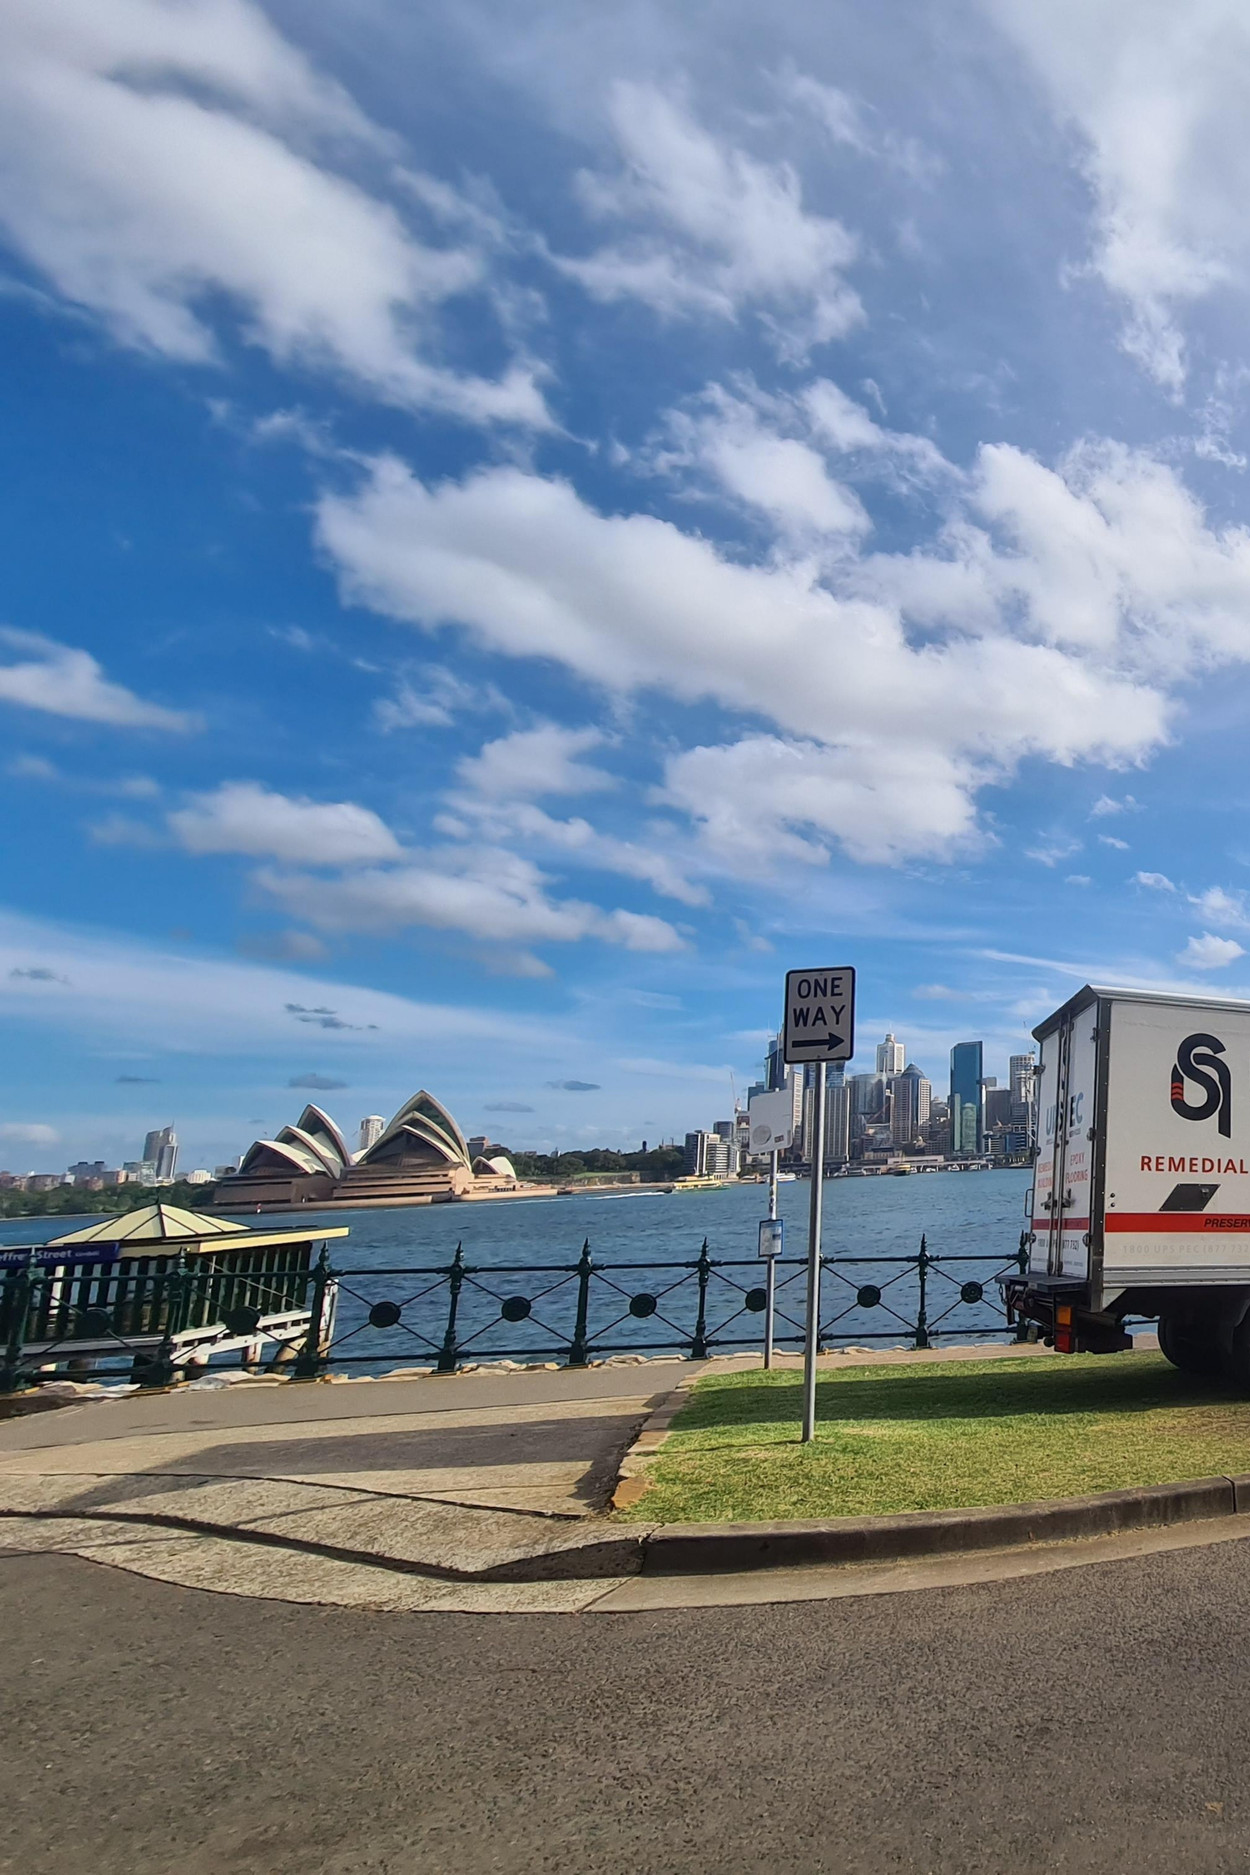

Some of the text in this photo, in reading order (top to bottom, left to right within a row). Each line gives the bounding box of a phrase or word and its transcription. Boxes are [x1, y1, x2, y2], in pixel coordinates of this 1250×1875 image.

[797, 977, 843, 999] ONE
[793, 1004, 846, 1028] WAY
[1140, 1155, 1248, 1174] REMEDIAL
[37, 1250, 72, 1259] Street
